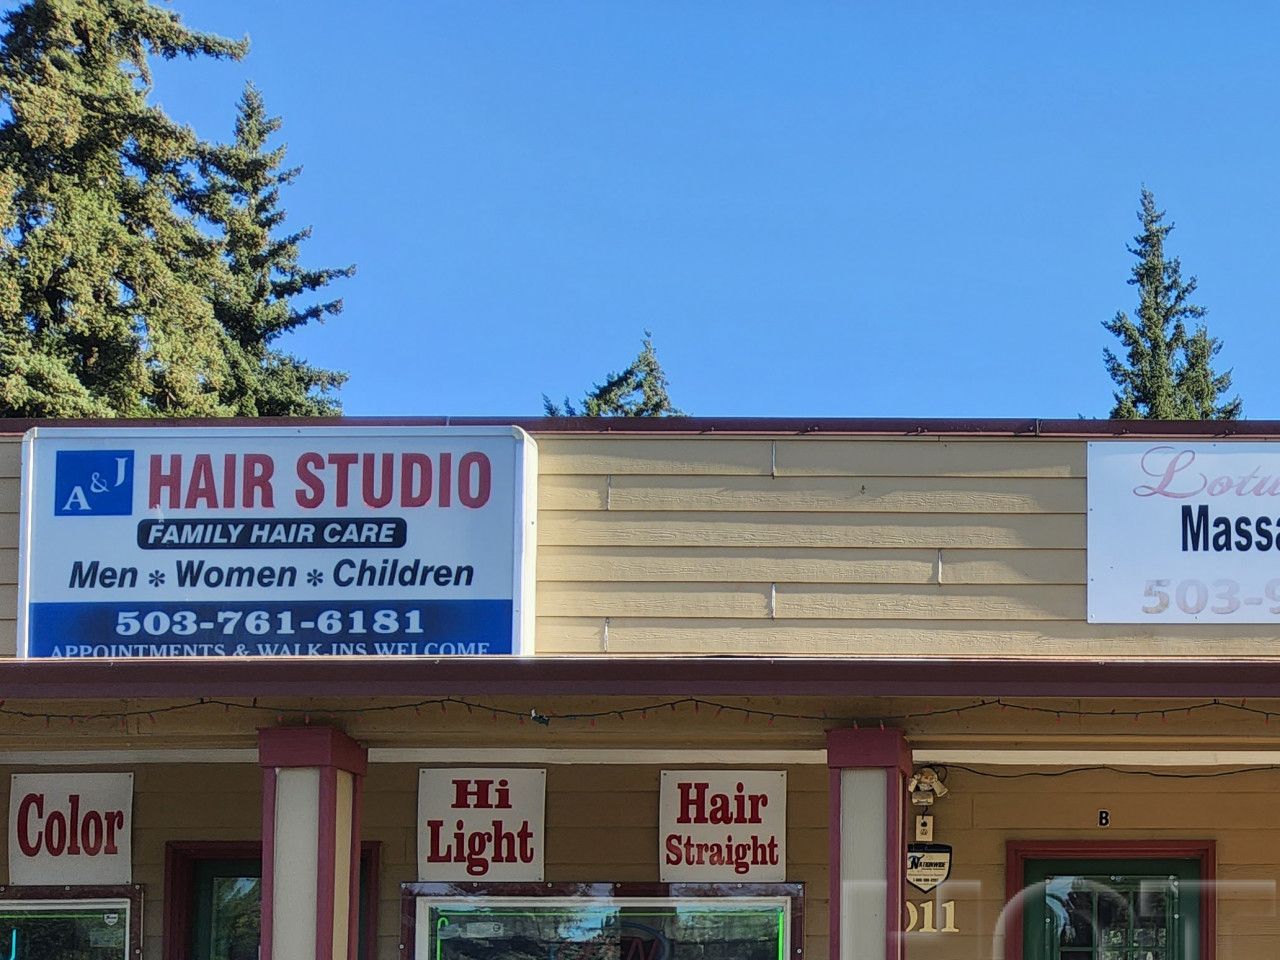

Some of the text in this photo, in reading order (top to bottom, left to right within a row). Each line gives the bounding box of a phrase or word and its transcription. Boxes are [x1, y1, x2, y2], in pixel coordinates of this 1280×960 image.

[62, 457, 129, 511] A & J
[149, 451, 493, 510] HAIR STUDIO
[148, 522, 396, 544] FAMILY HAIR CARE
[69, 559, 475, 589] Men Women Children
[115, 609, 425, 637] 503-761-6181
[51, 643, 225, 657] APPOINTMENTS
[232, 643, 249, 656] &
[374, 642, 490, 655] WELCOME
[451, 779, 512, 809] Hi
[676, 782, 769, 824] Hair
[17, 793, 124, 857] Color
[1098, 809, 1110, 827] B
[427, 819, 534, 876] Light
[665, 834, 779, 874] Straight
